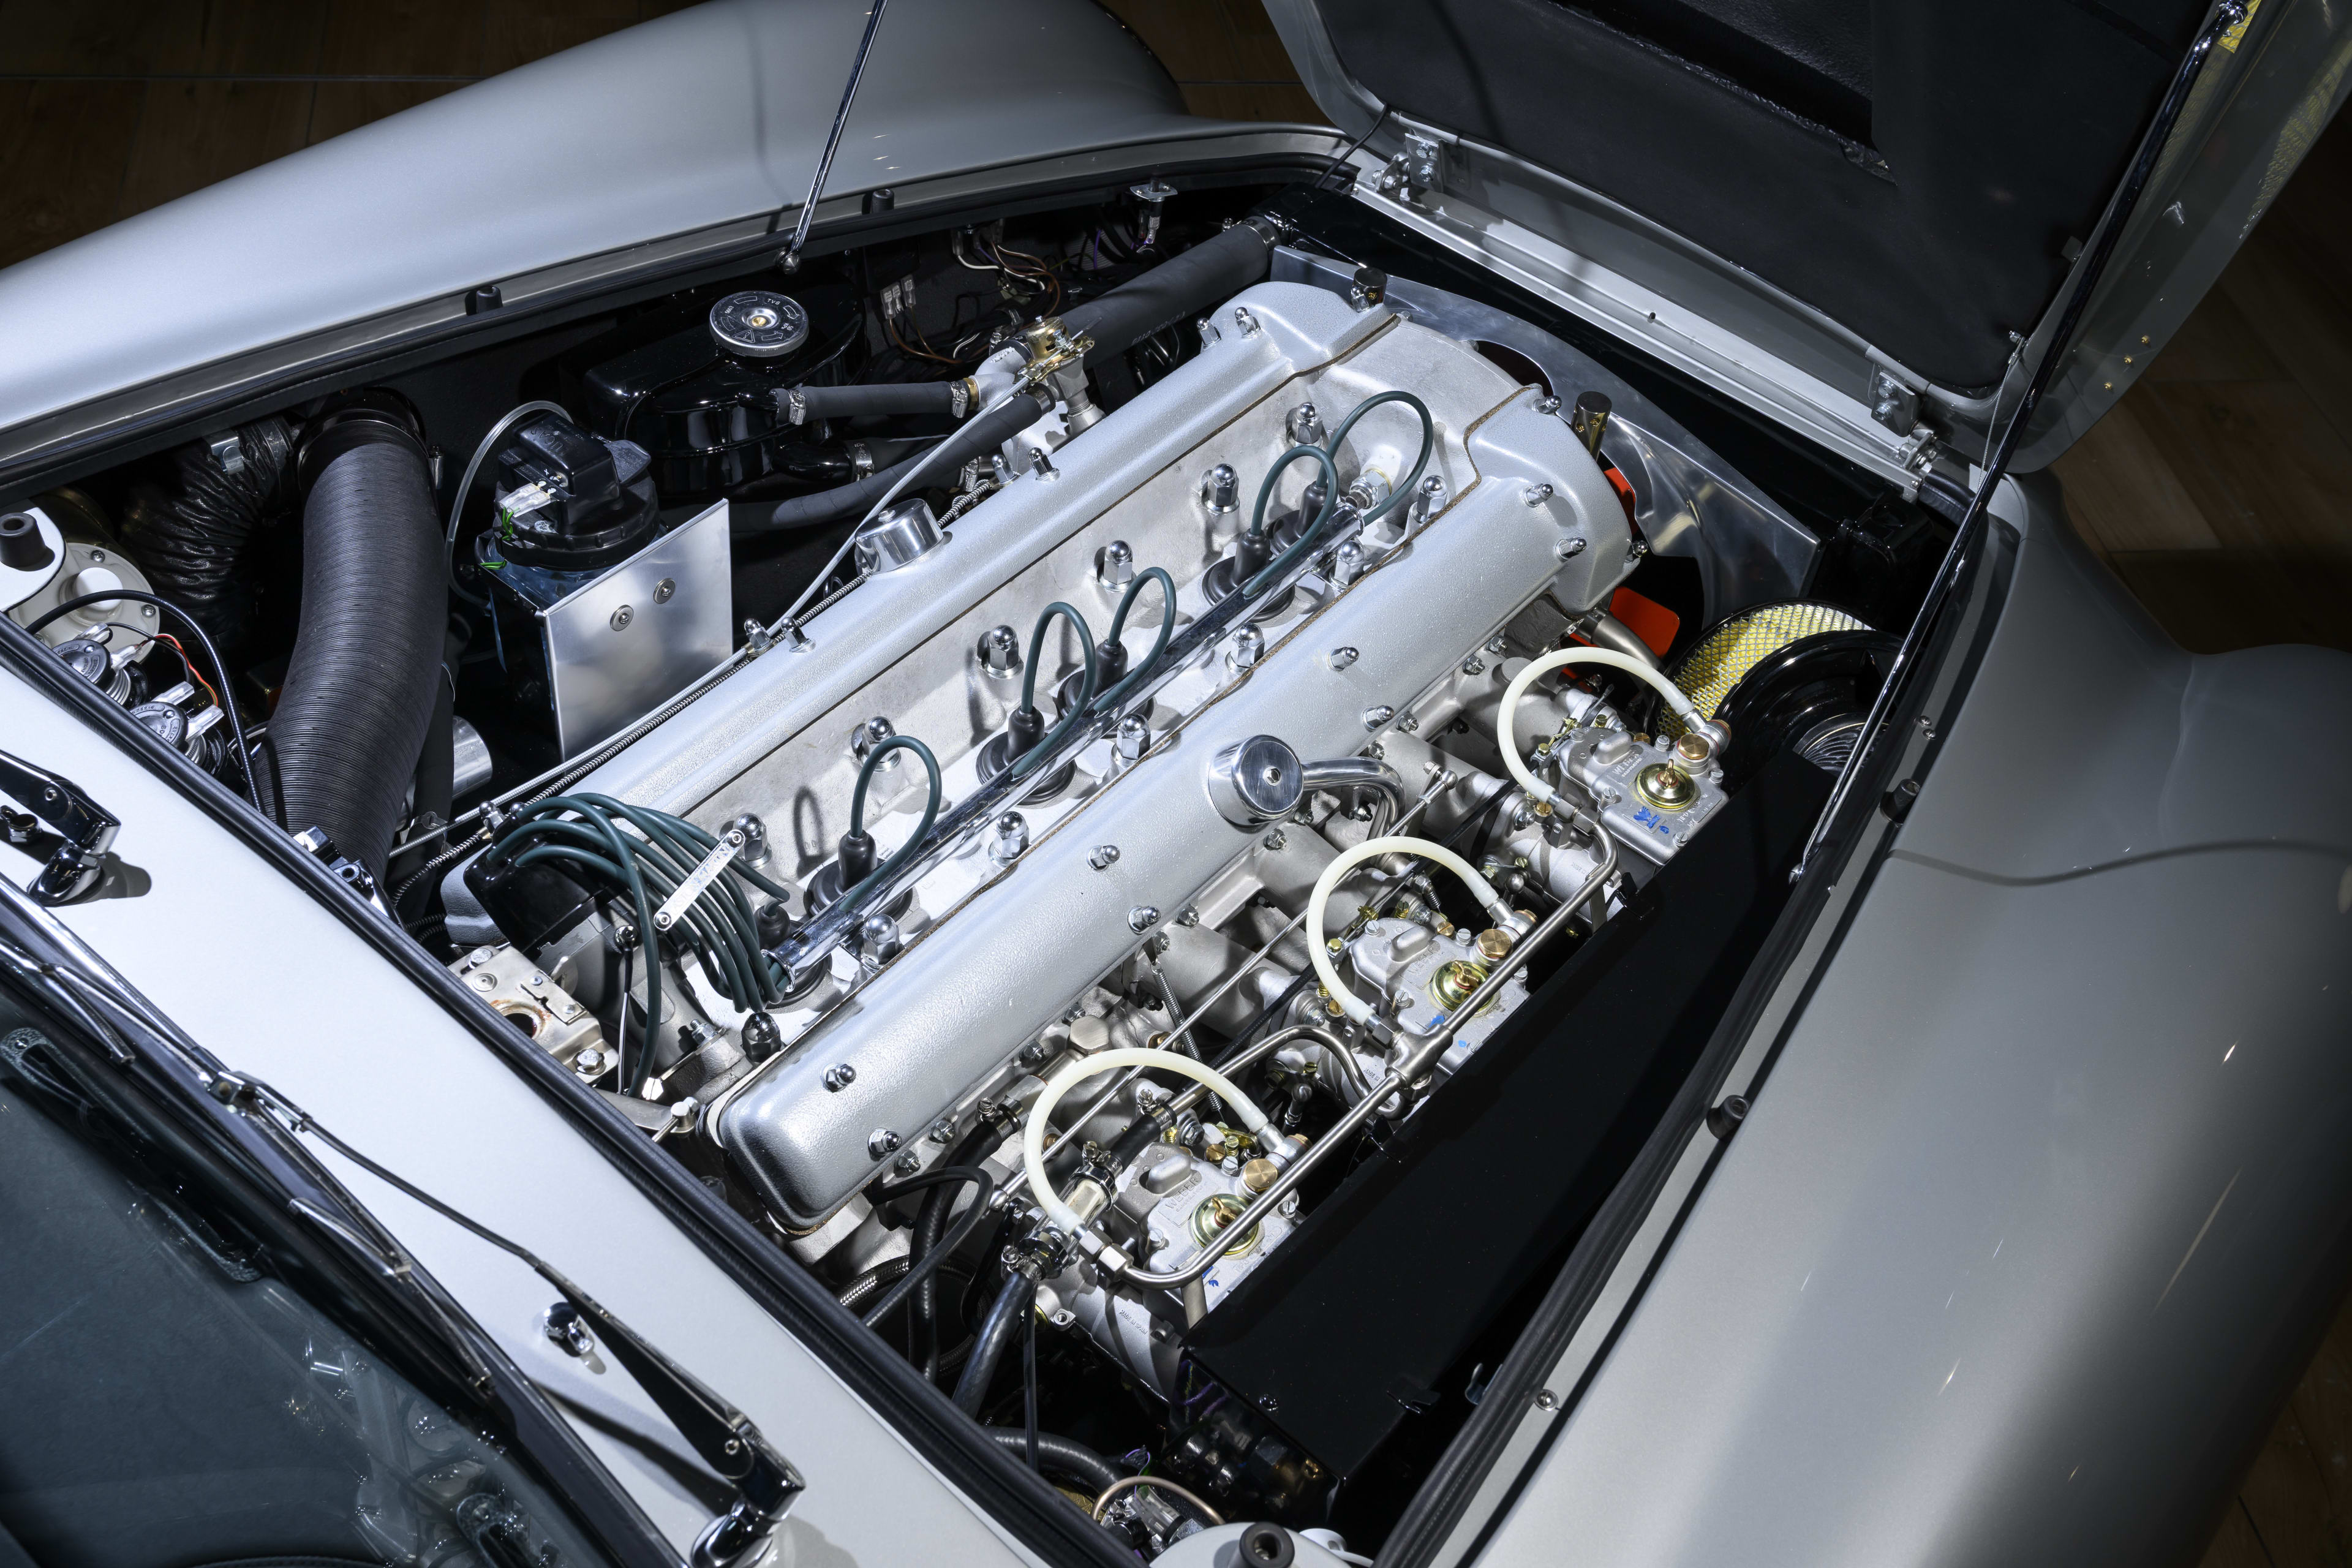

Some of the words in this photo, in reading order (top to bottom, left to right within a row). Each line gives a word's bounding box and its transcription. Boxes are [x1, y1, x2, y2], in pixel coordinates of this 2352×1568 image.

[1164, 1176, 1202, 1208] WEBER
[1118, 1309, 1132, 1322] MADE
[1134, 1322, 1148, 1335] SPAIN
